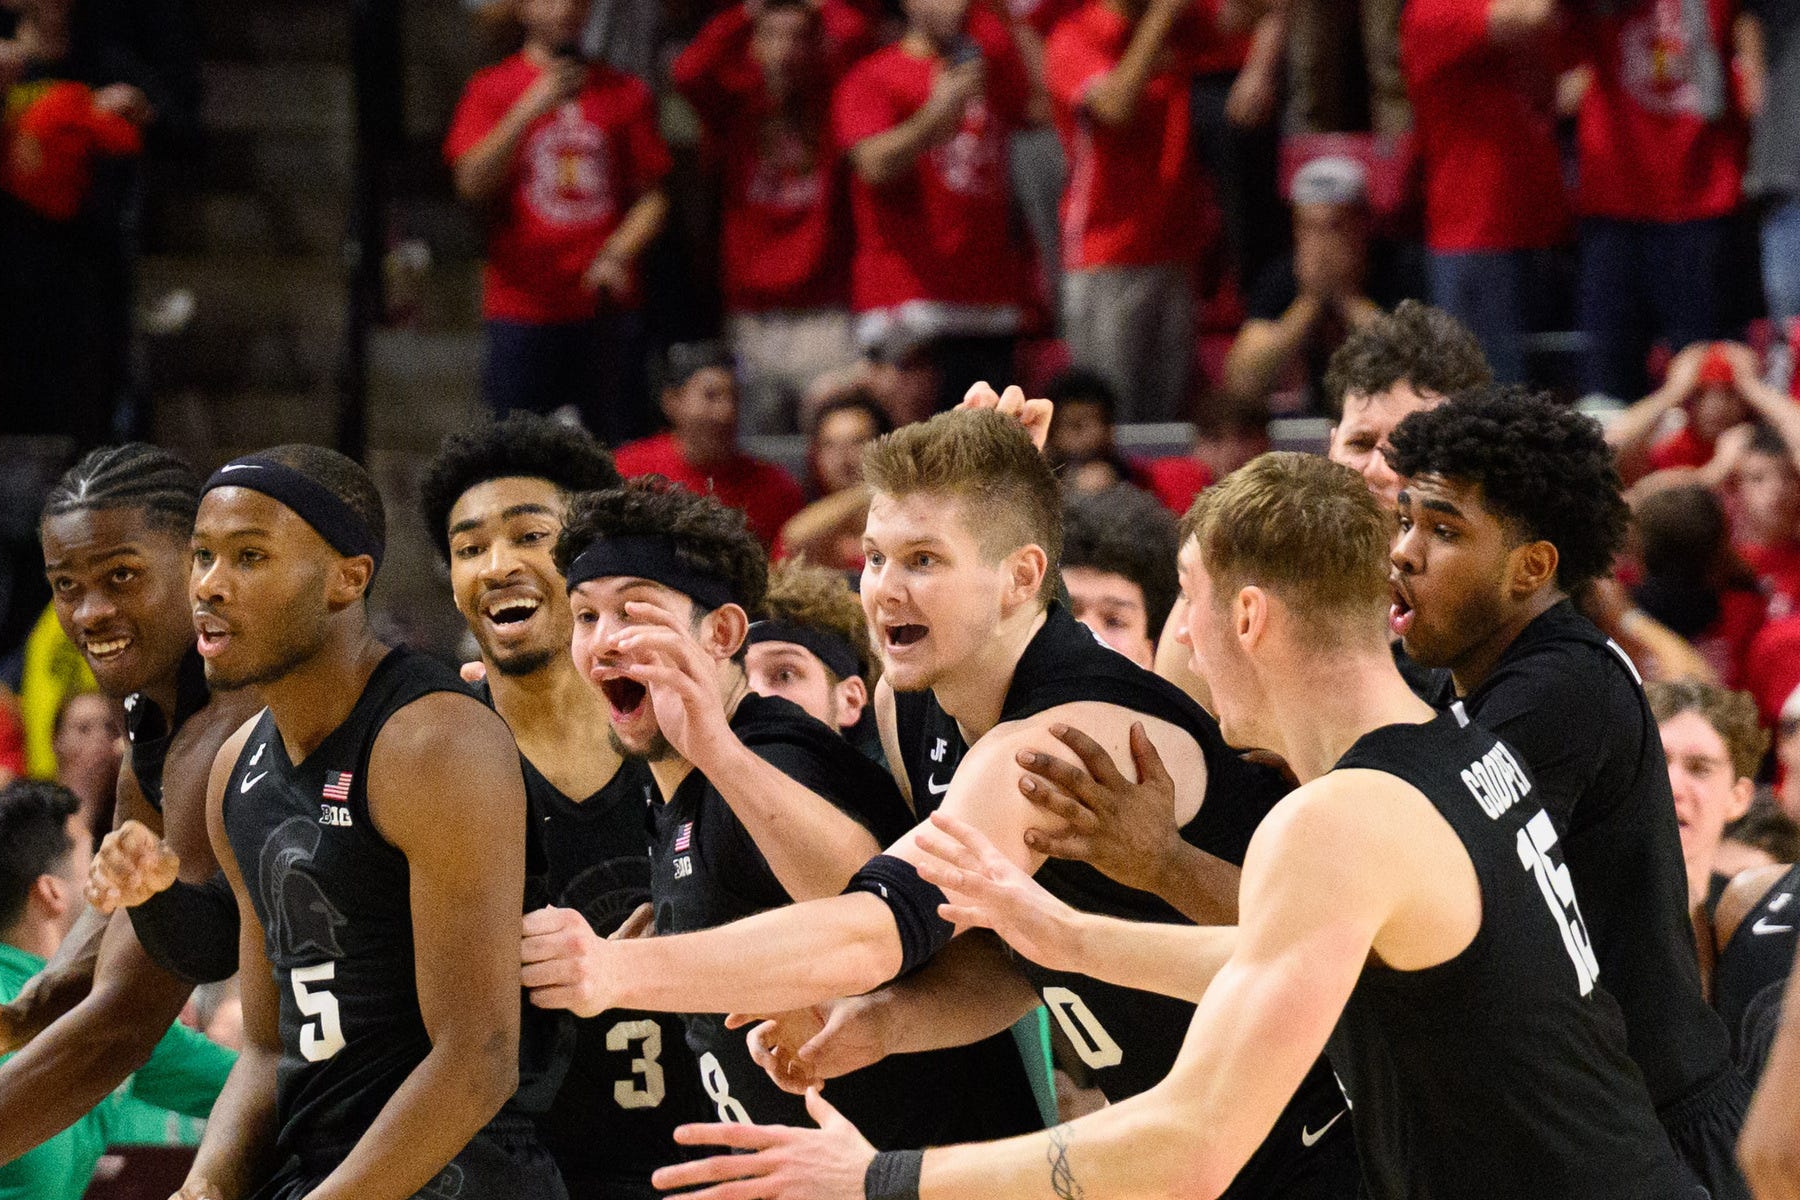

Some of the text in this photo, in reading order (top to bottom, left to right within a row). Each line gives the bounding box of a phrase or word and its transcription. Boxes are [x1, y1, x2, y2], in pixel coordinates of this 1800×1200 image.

[1517, 808, 1599, 997] 15
[290, 961, 347, 1062] 5
[1043, 987, 1123, 1070] 0
[606, 1019, 666, 1109] 3
[700, 1051, 756, 1125] 8
